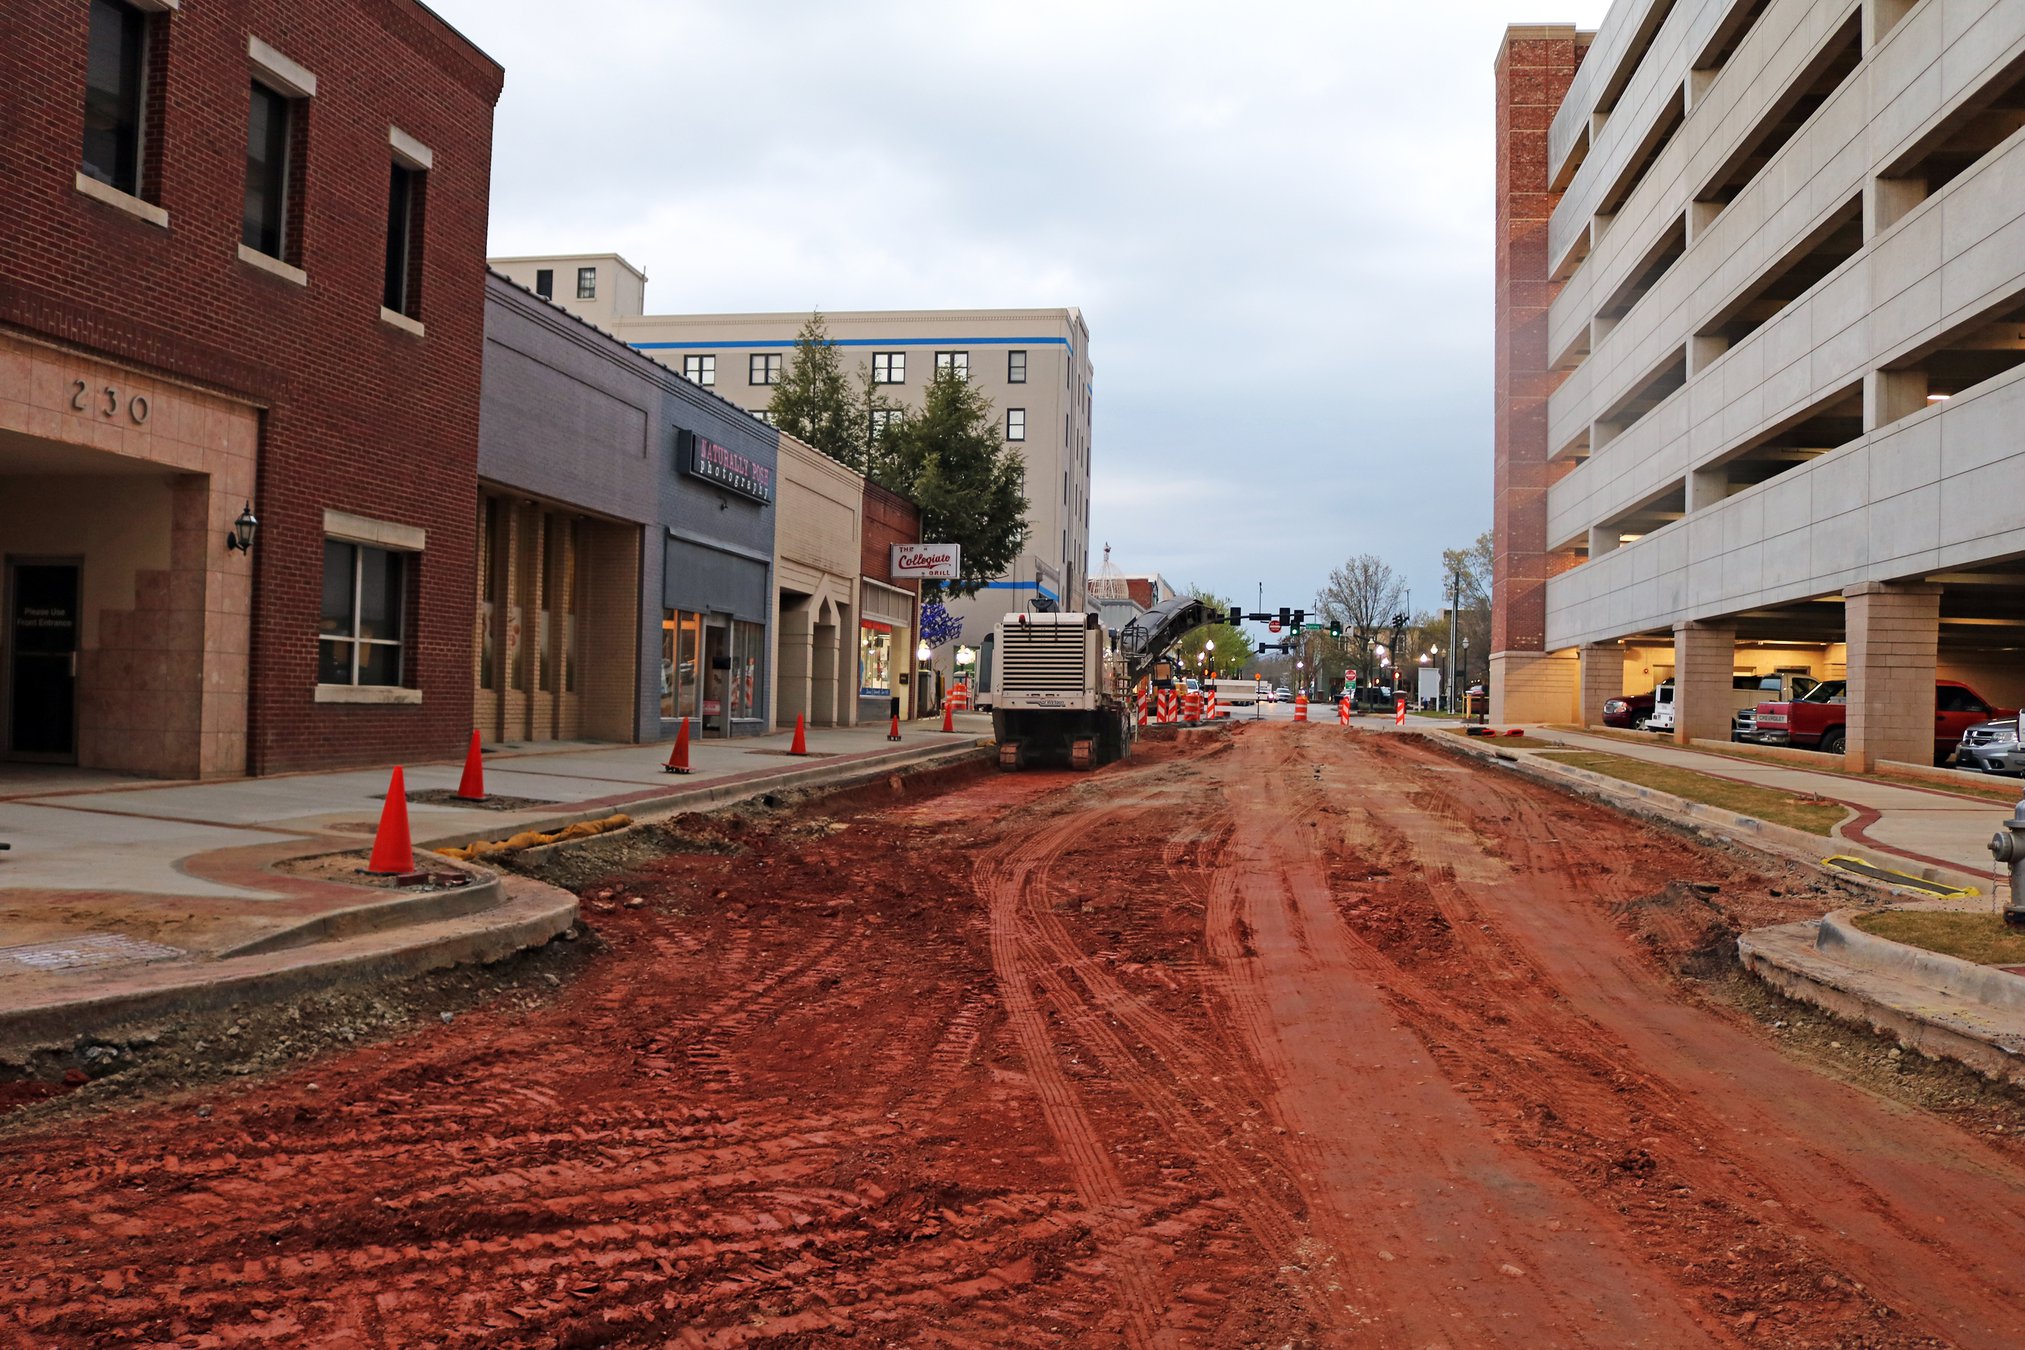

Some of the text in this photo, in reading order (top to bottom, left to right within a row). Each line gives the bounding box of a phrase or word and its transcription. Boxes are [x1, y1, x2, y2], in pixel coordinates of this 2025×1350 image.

[72, 379, 150, 425] 230
[701, 437, 749, 477] NATURALLY
[700, 460, 769, 500] photography
[898, 553, 951, 569] Collegiate
